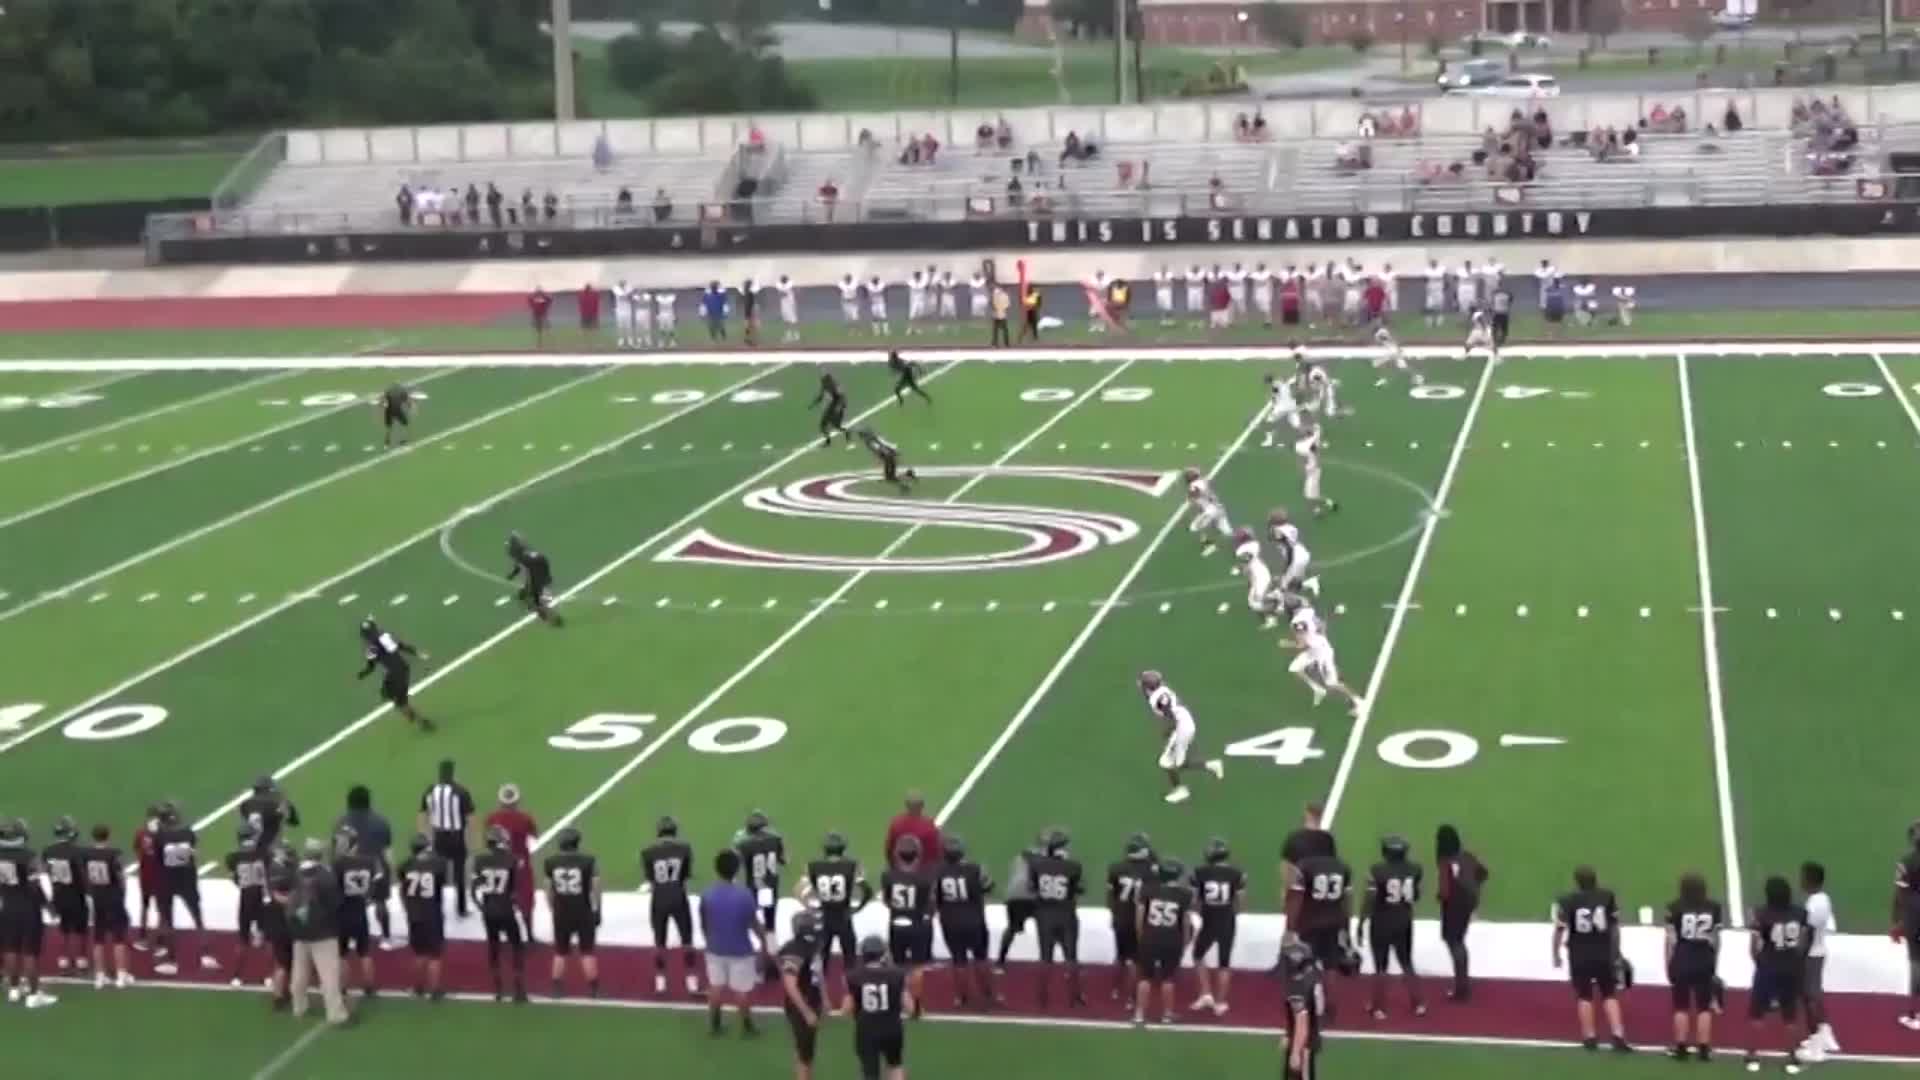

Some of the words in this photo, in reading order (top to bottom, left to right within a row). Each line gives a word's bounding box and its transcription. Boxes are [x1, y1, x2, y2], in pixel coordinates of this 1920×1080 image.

[1028, 220, 1112, 242] THIS
[1142, 220, 1177, 241] IS
[1207, 216, 1379, 240] SENATOR
[1411, 212, 1590, 237] COUNTRY
[404, 871, 435, 898] 79
[480, 868, 509, 894] 37
[552, 867, 582, 895] 52
[940, 876, 969, 901] 91
[1204, 880, 1231, 905] 21
[1312, 873, 1343, 900] 93
[1385, 877, 1416, 903] 94
[891, 883, 916, 910] 51
[1148, 901, 1179, 927] 55
[1574, 906, 1607, 933] 64
[861, 982, 890, 1012] 61
